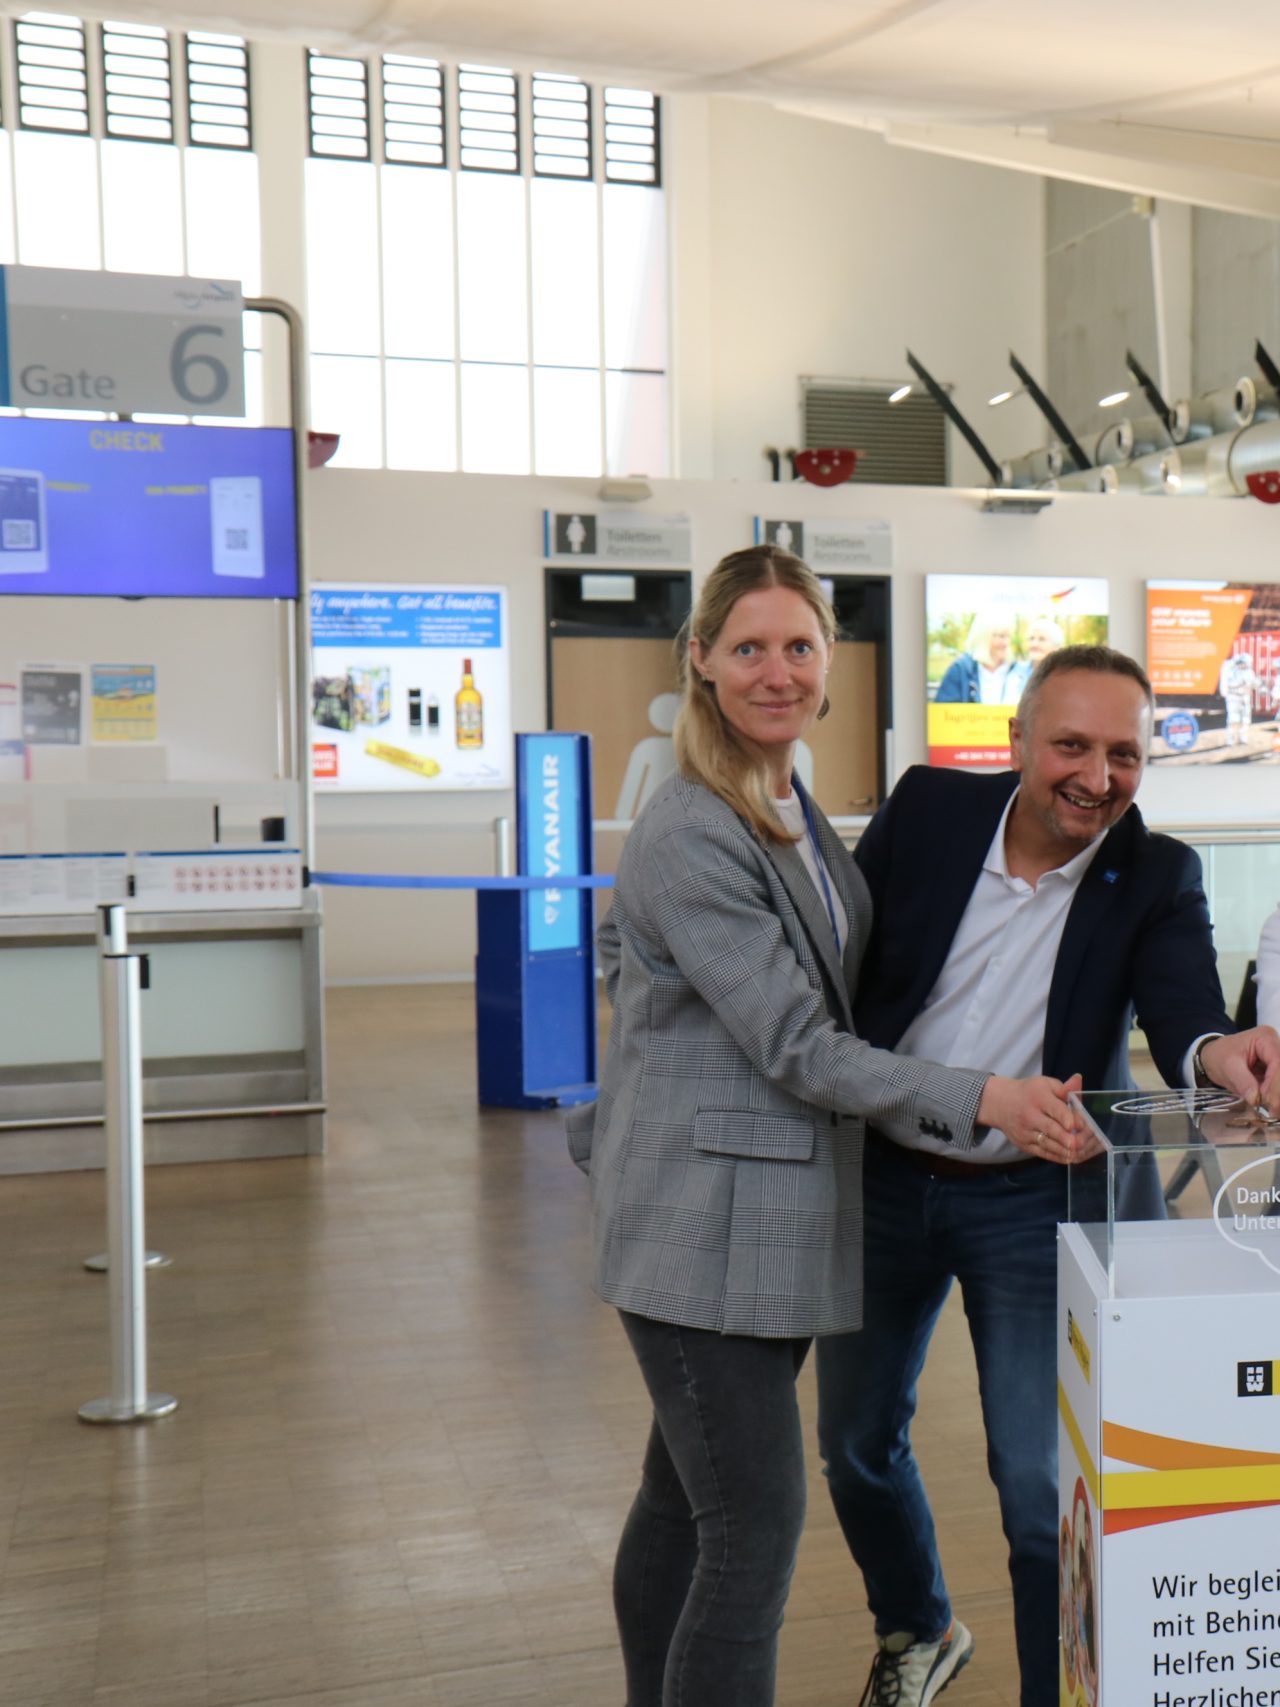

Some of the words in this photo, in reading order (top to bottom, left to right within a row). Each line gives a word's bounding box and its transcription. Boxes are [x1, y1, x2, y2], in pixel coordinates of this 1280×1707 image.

[19, 363, 116, 400] Gate
[169, 323, 230, 406] 6
[89, 430, 165, 452] CHECK
[606, 528, 662, 543] Toiletten
[813, 536, 865, 549] Toiletten
[1152, 1575, 1198, 1599] Wir
[1153, 1613, 1195, 1637] mit
[1154, 1650, 1234, 1676] Helfen
